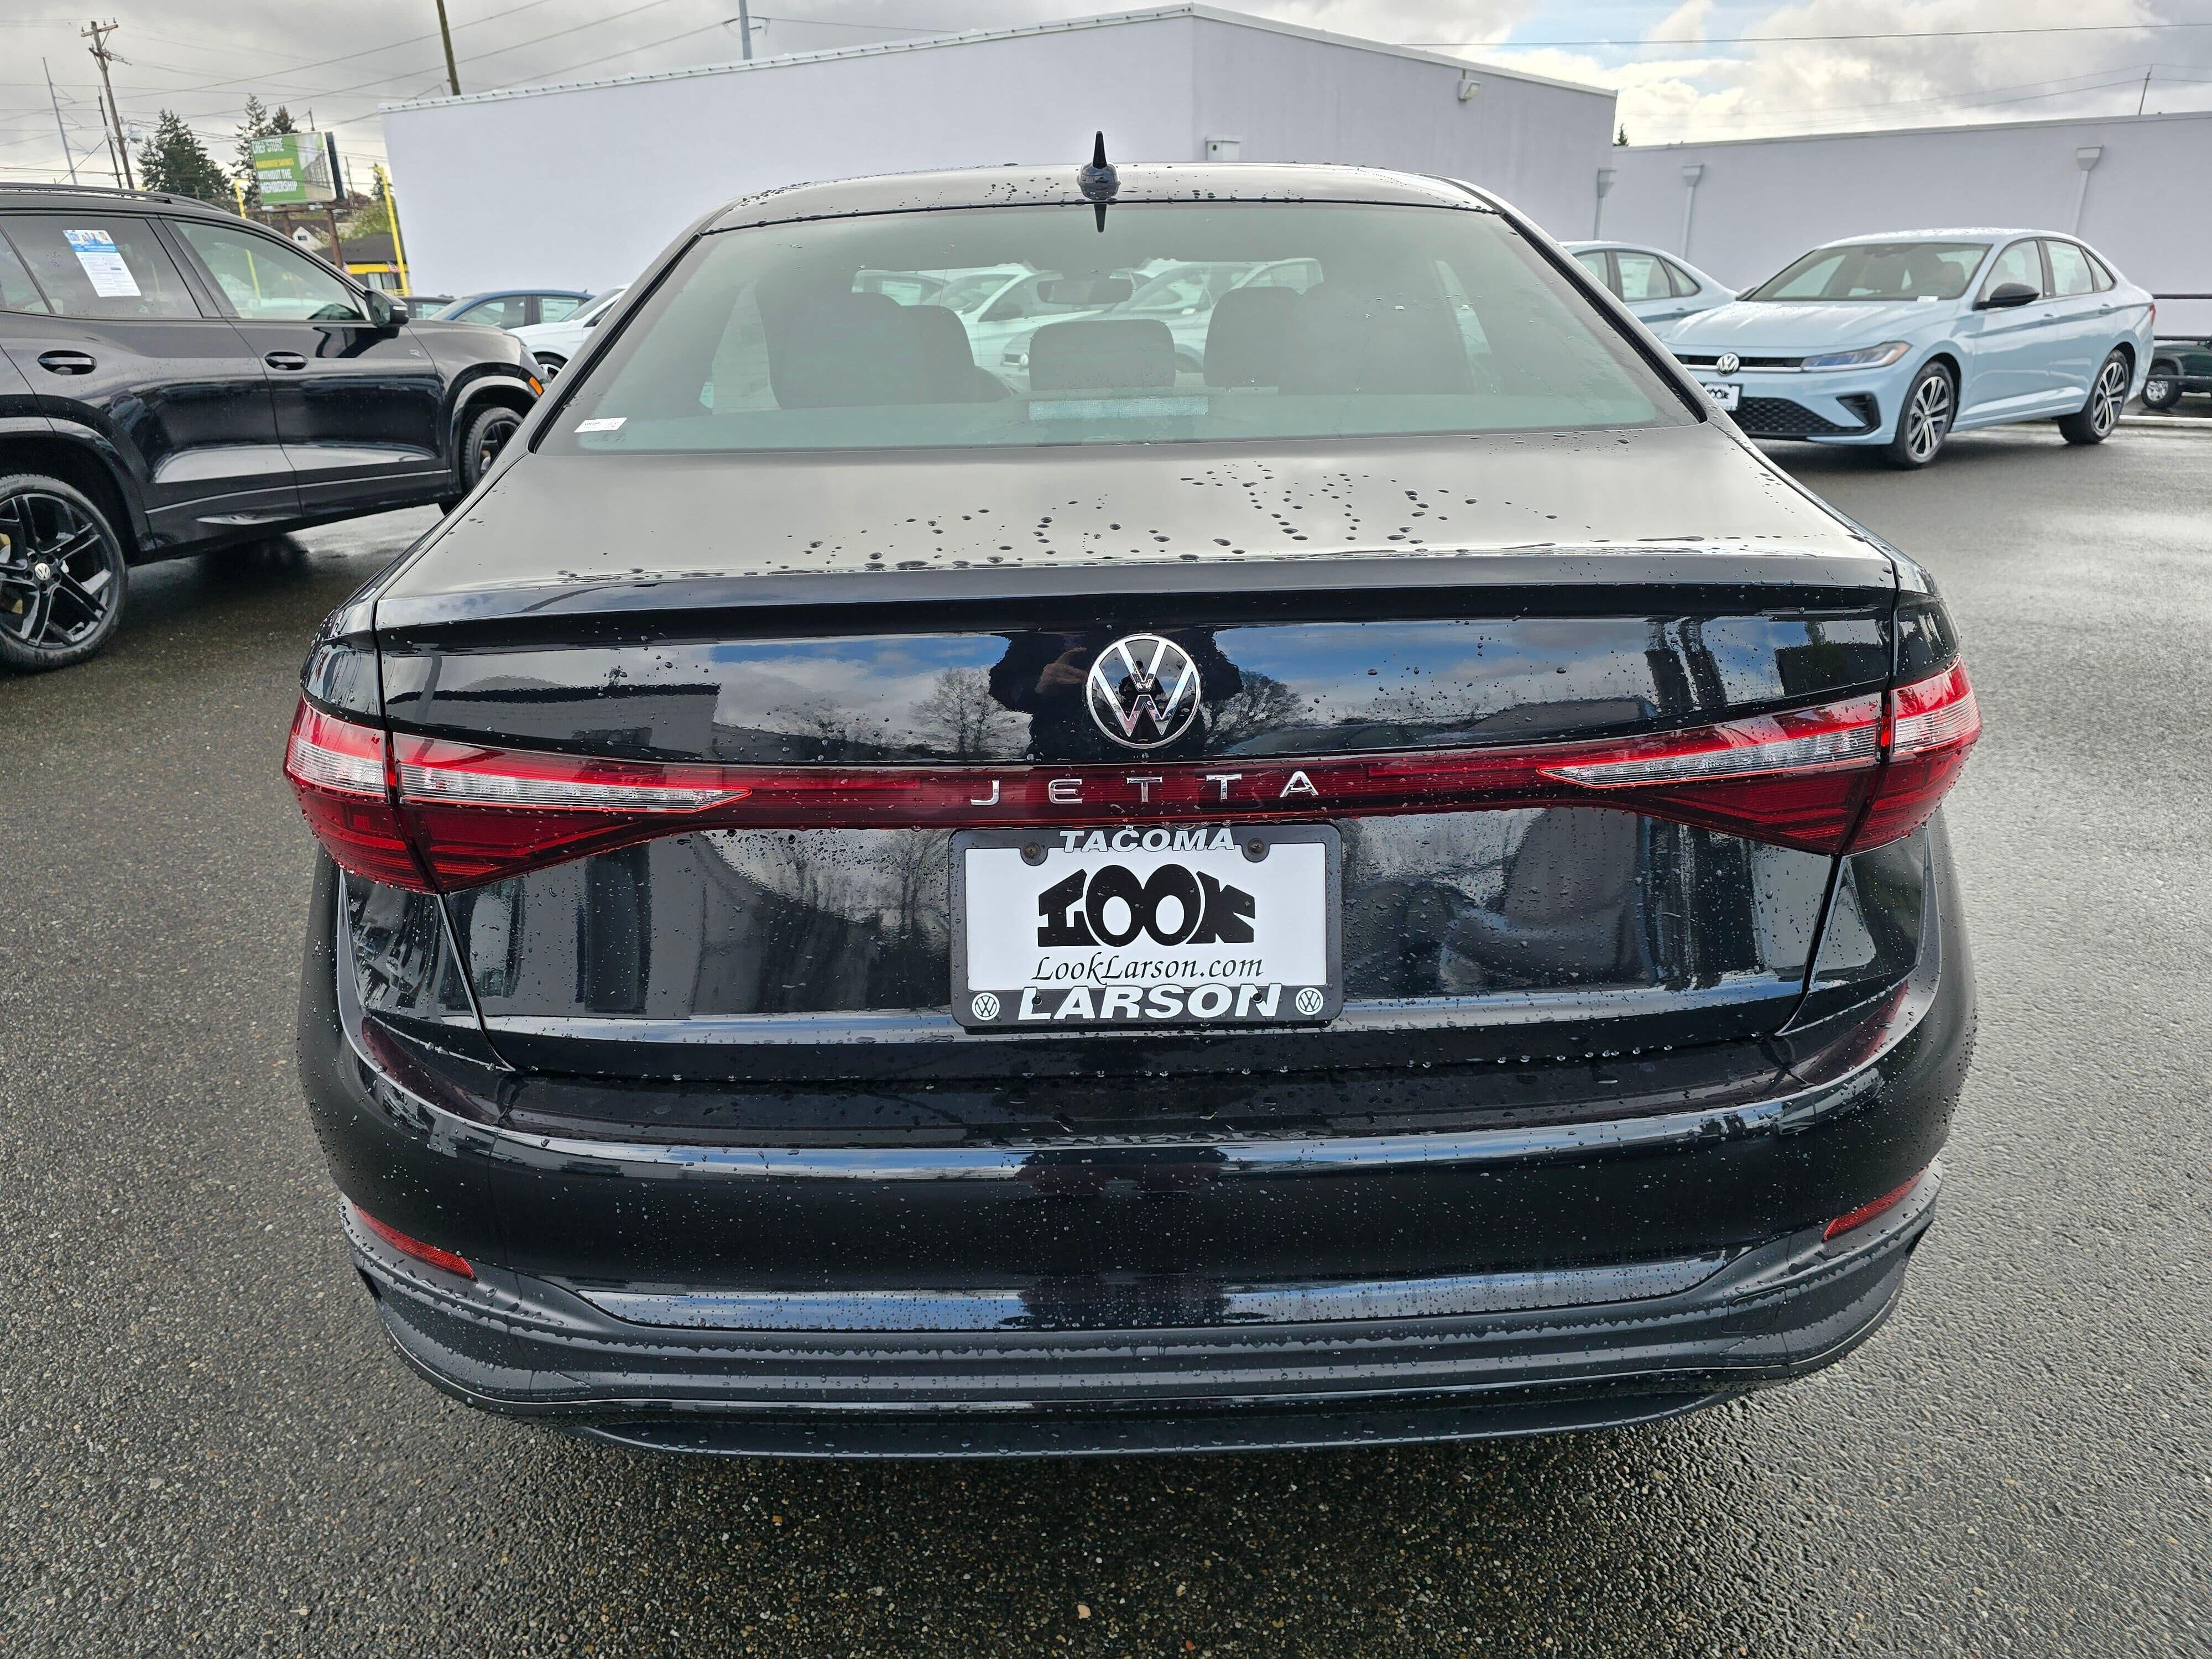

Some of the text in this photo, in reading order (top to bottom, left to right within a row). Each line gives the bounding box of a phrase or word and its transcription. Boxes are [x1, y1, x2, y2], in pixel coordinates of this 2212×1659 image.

[257, 168, 293, 180] WITHOUT THE
[259, 180, 298, 194] MEMBERSHIP
[1087, 633, 1201, 748] VW
[971, 770, 1319, 806] JETTA
[1059, 828, 1235, 853] TACOMA
[1037, 864, 1255, 947] LOOK
[1030, 951, 1264, 985] LookLarson.com
[1018, 983, 1282, 1020] LARSON
